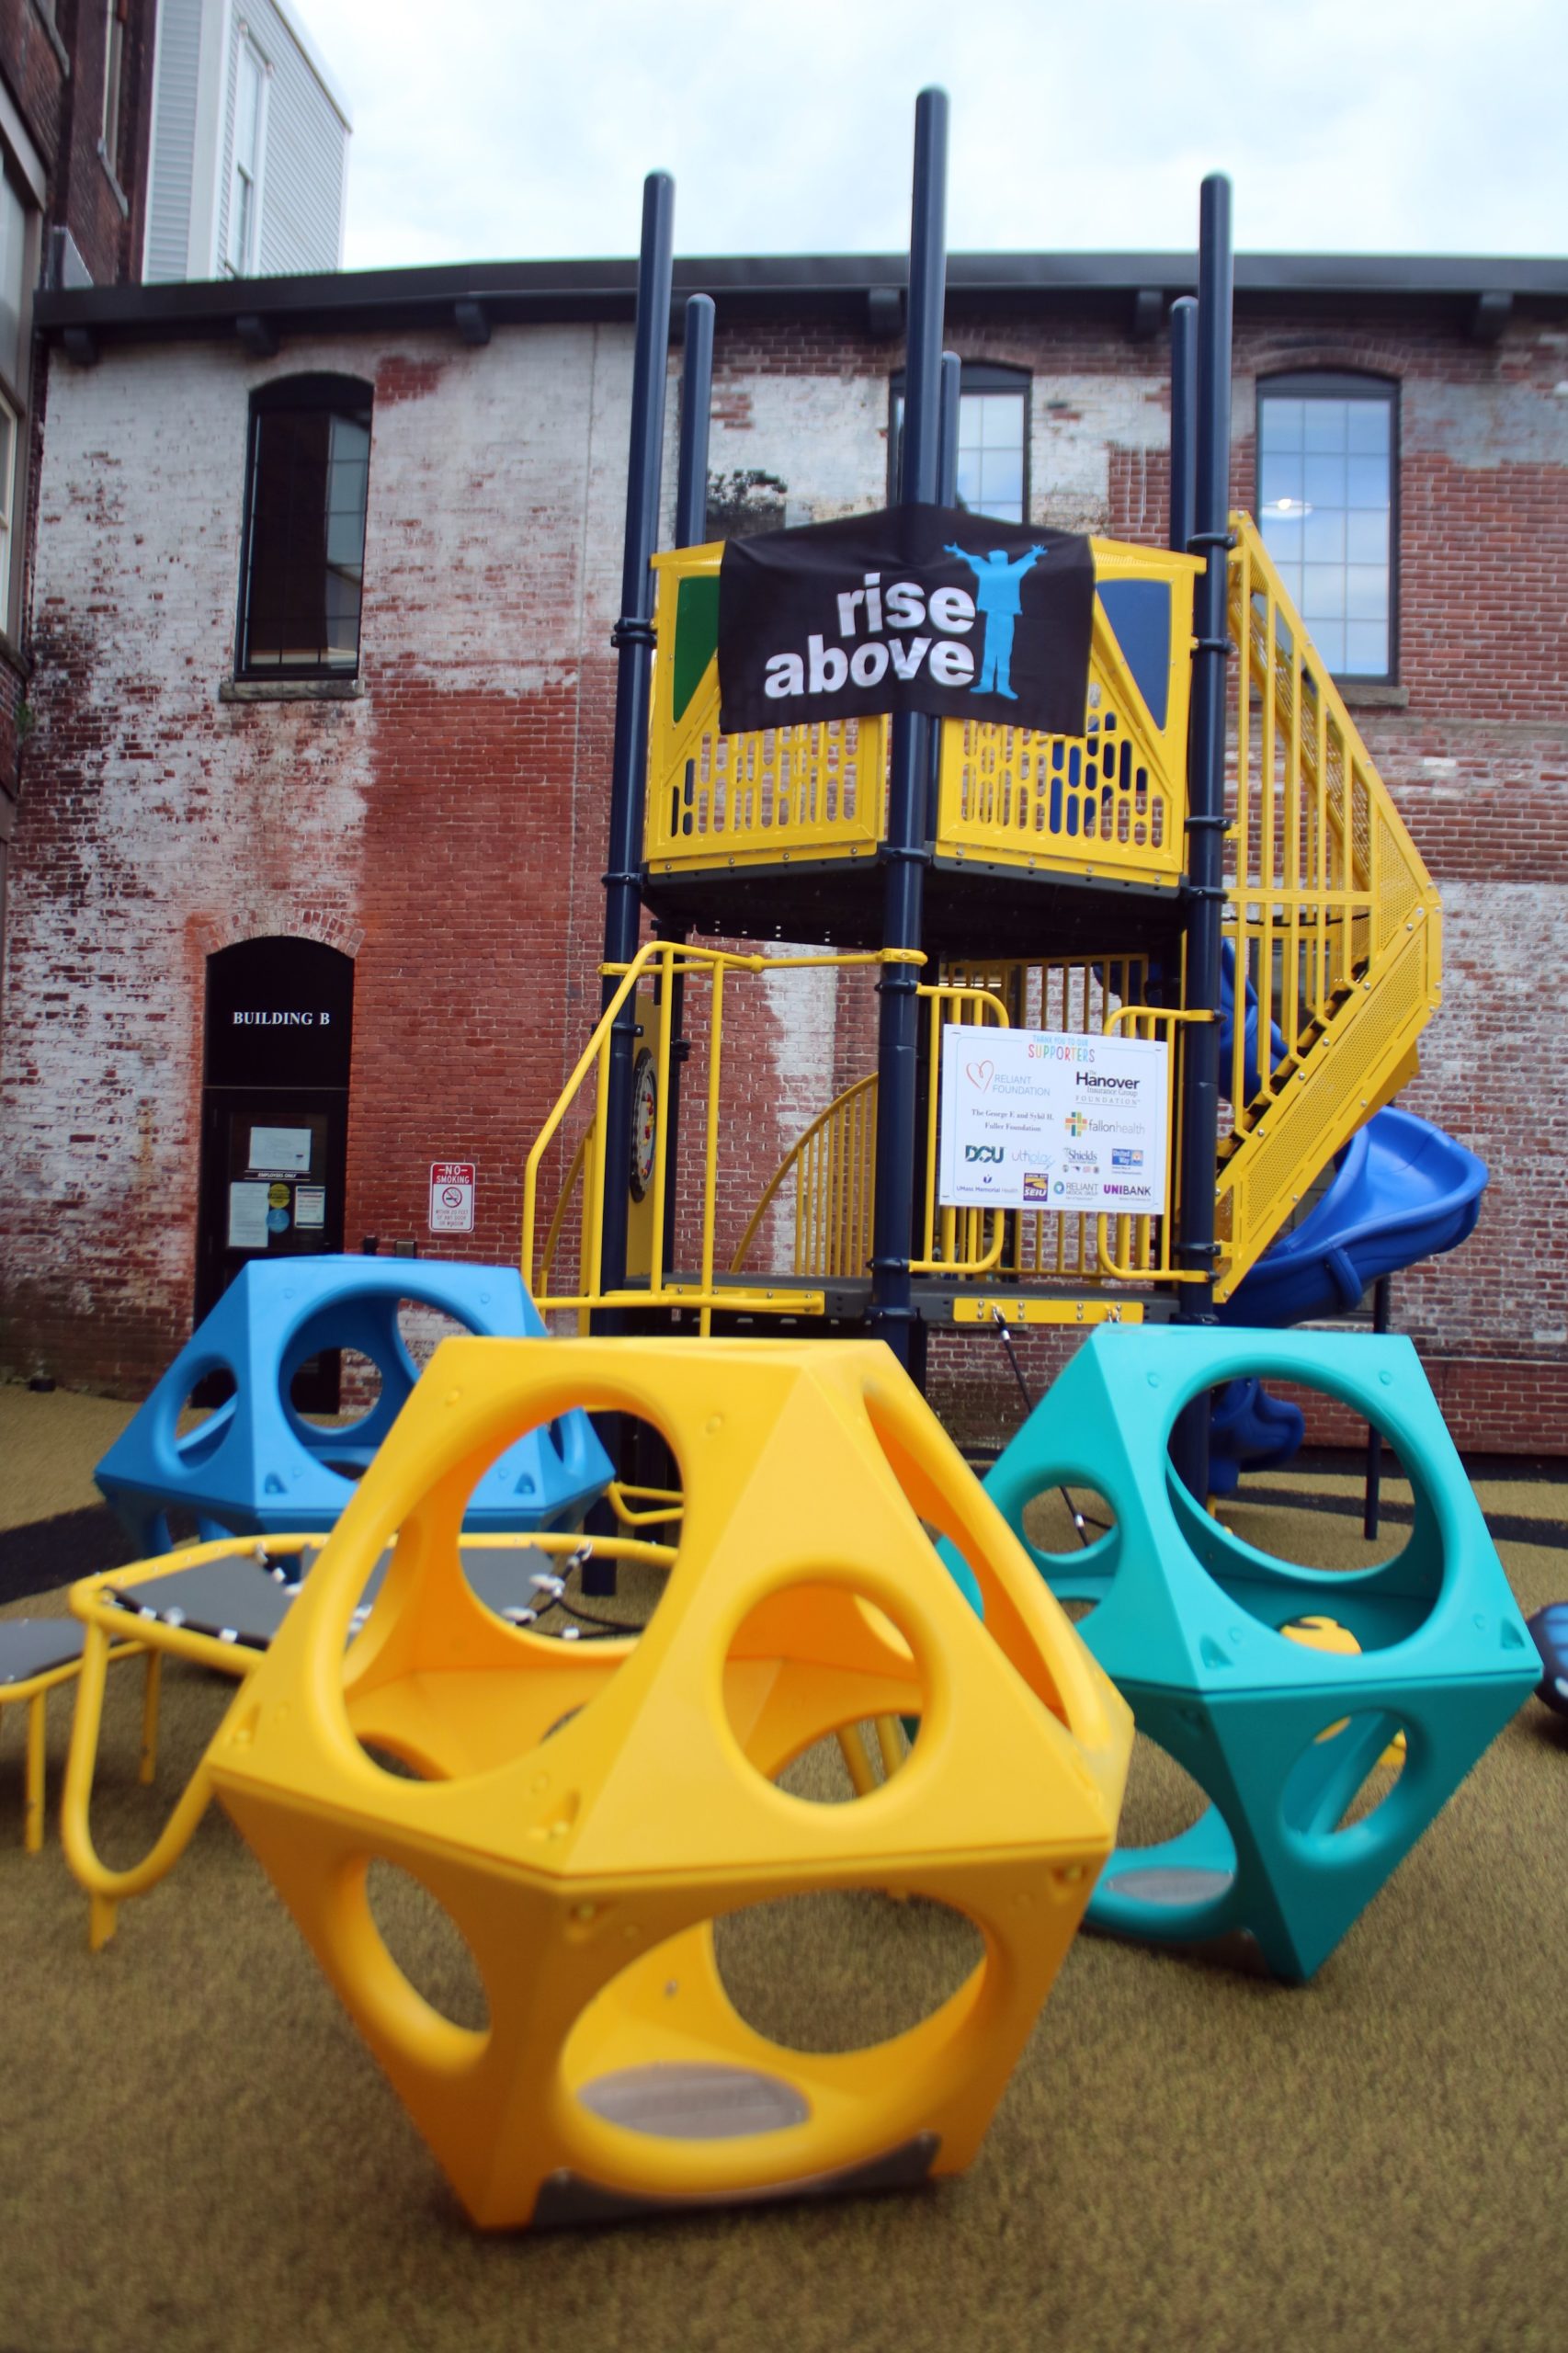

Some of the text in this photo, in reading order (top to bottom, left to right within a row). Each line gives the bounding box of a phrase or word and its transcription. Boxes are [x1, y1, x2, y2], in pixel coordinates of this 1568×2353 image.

[836, 572, 976, 638] rise
[764, 634, 975, 699] above
[233, 1011, 330, 1025] BUILDING B
[1033, 1035, 1088, 1046] THANK YOU TO OUR
[1028, 1044, 1095, 1063] SUPPORTERS
[994, 1074, 1031, 1084] RELIANT
[1075, 1071, 1140, 1089] Hanover
[993, 1085, 1051, 1096] FOUNDATION
[1086, 1086, 1138, 1097] Insurance Group
[985, 1109, 1008, 1119] George
[1017, 1110, 1028, 1119] and
[984, 1121, 1041, 1131] Fuller Foundation
[1088, 1119, 1145, 1134] fallonhealth
[965, 1144, 1004, 1164] DCU
[1069, 1150, 1097, 1161] Shields
[445, 1165, 460, 1176] NO
[436, 1176, 470, 1184] SMOKING
[1066, 1182, 1099, 1191] RELIANT
[1103, 1184, 1152, 1196] UNIBANK
[1024, 1188, 1047, 1197] SEIU
